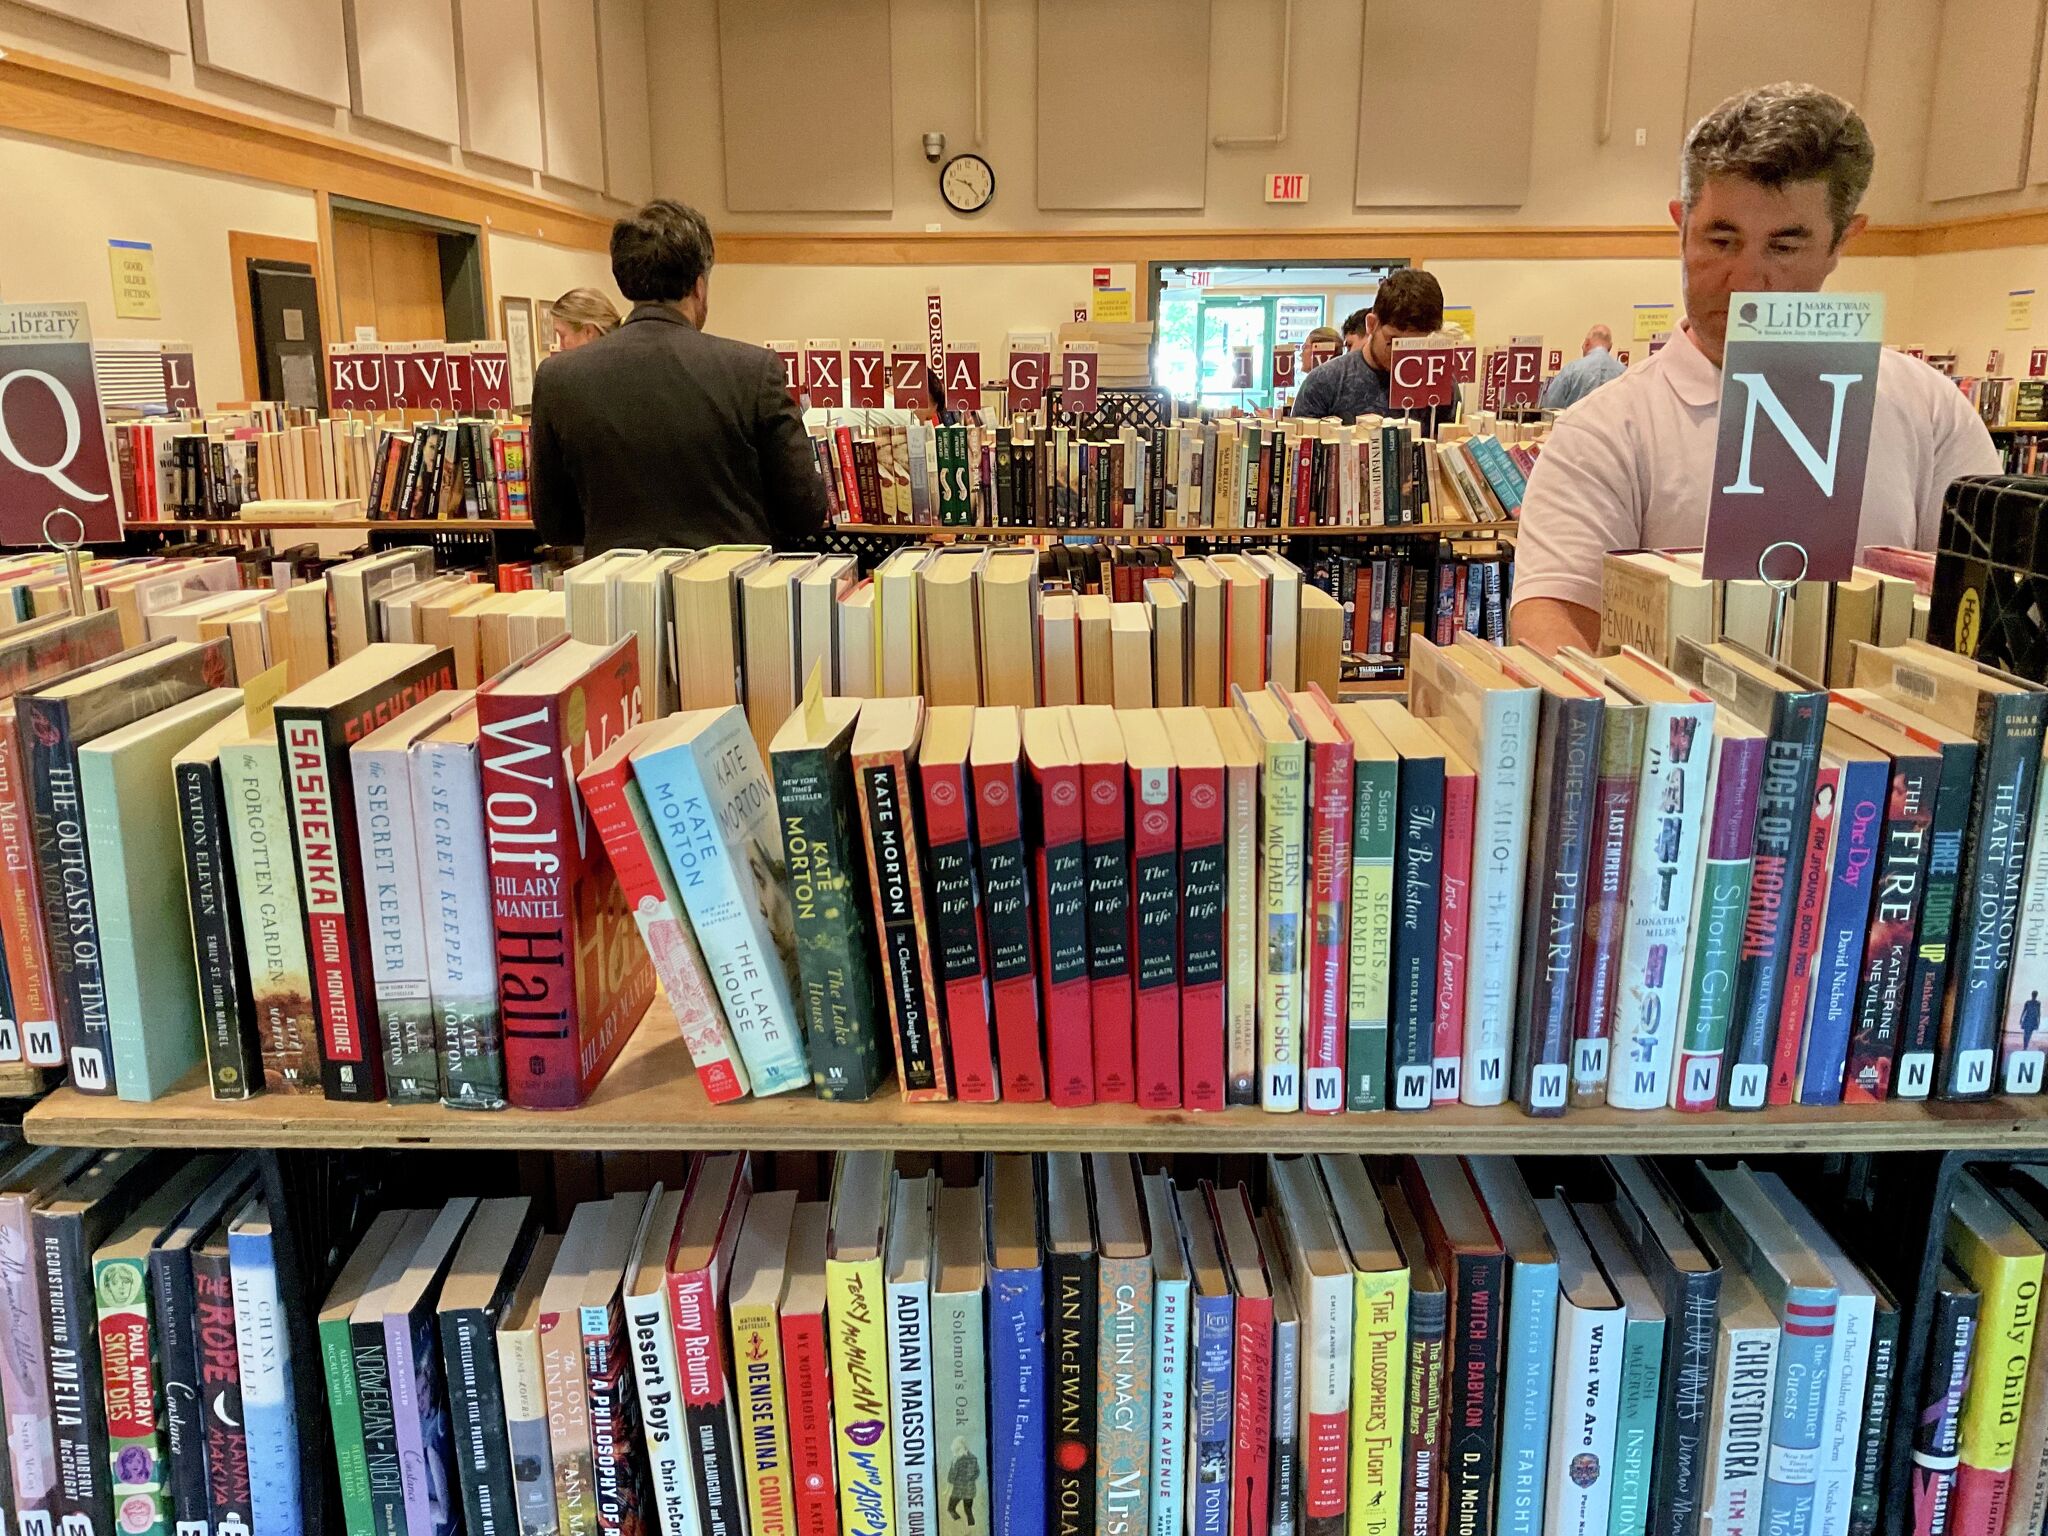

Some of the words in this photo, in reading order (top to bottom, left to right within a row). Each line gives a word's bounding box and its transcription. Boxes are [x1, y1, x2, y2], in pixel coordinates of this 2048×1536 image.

[1274, 176, 1303, 199] EXIT
[124, 288, 151, 299] FICTION
[1192, 272, 1209, 285] EXIT
[1765, 302, 1871, 336] Library
[168, 360, 190, 388] L
[333, 361, 353, 390] K
[352, 360, 381, 390] U
[394, 360, 406, 397] J
[415, 359, 442, 389] V
[449, 362, 461, 390] I
[475, 359, 506, 390] W
[811, 357, 839, 387] X
[853, 358, 881, 387] Y
[897, 360, 923, 389] Z
[949, 360, 976, 390] A
[1012, 360, 1039, 389] G
[1068, 361, 1090, 390] B
[1235, 358, 1250, 375] T
[1275, 356, 1294, 374] U
[1394, 357, 1423, 388] C
[1426, 357, 1446, 386] F
[1457, 351, 1473, 371] Y
[1496, 353, 1508, 375] Z
[1512, 354, 1535, 383] E
[1551, 353, 1559, 364] B
[1618, 354, 1628, 365] C
[2033, 353, 2043, 367] T
[0, 369, 109, 502] Q
[1723, 373, 1863, 498] N
[1602, 600, 1656, 654] PENMAN
[1960, 598, 1976, 655] Hood
[714, 743, 748, 791] KATE
[1761, 740, 1803, 812] EDGE
[50, 766, 74, 815] THE
[187, 771, 209, 846] STATION
[481, 706, 561, 875] Wolf
[719, 773, 771, 840] MORTON
[873, 772, 894, 822] KATE
[1903, 775, 1923, 817] THE
[290, 727, 338, 906] SASHENKA
[685, 797, 717, 859] KATE
[1361, 780, 1374, 843] Meissner
[1377, 790, 1392, 833] Susan
[1408, 805, 1436, 840] The
[1762, 813, 1792, 850] OF
[655, 782, 704, 888] MORTON
[57, 820, 92, 935] OUTCASTS
[786, 817, 815, 920] MORTON
[812, 840, 833, 892] KATE
[877, 829, 905, 915] MORTON
[990, 854, 1015, 870] The
[1190, 859, 1216, 874] The
[1267, 824, 1285, 908] MICHAELS
[1878, 829, 1924, 925] FIRE
[196, 850, 216, 916] ELEVEN
[495, 876, 561, 897] HILARY
[987, 875, 1021, 894] Paris
[1185, 881, 1220, 899] Paris
[1405, 842, 1433, 931] Bookstore
[496, 898, 565, 919] MANTEL
[992, 897, 1021, 915] Wife
[1189, 903, 1217, 920] Wife
[1352, 875, 1370, 966] CHARMED
[1635, 915, 1686, 927] JONATHAN
[1704, 884, 1741, 964] Short
[1741, 854, 1793, 962] NORMAL
[318, 918, 341, 963] SIMON
[1545, 870, 1578, 983] PEARL
[1645, 927, 1677, 937] MILES
[75, 937, 99, 969] OF
[996, 957, 1027, 968] McLAIN
[997, 944, 1024, 955] PAULA
[1189, 950, 1216, 961] PAULA
[1835, 929, 1854, 966] David
[497, 926, 570, 1041] Hall
[1188, 962, 1218, 974] McLAIN
[80, 973, 108, 1034] TIME
[325, 965, 353, 1056] MONTEFIORE
[719, 963, 754, 1033] HOUSE
[734, 940, 758, 983] THE
[751, 987, 779, 1042] LAKE
[1350, 970, 1366, 1011] LIFE
[1696, 975, 1728, 1036] Girls
[1827, 967, 1847, 1022] Nicholls
[1860, 958, 1883, 1029] NEVILLE
[1877, 944, 1904, 1040] KATHERINE
[386, 1009, 404, 1067] MORTON
[1435, 1068, 1456, 1089] M
[1479, 1058, 1500, 1080] M
[1581, 1049, 1602, 1072] M
[1692, 1068, 1711, 1091] N
[1907, 1063, 1926, 1085] N
[1968, 1060, 1986, 1082] N
[2018, 1061, 2035, 1084] N
[1273, 1075, 1292, 1096] M
[1316, 1078, 1336, 1100] M
[1403, 1075, 1425, 1097] M
[1538, 1076, 1561, 1098] M
[1634, 1070, 1655, 1094] M
[1740, 1074, 1760, 1097] N
[44, 1236, 68, 1342] RECONSTRUCTING
[677, 1281, 703, 1332] Nanny
[1061, 1275, 1081, 1320] IAN
[1115, 1284, 1135, 1365] CAITLIN
[2006, 1281, 2038, 1345] Only
[127, 1324, 143, 1364] PAUL
[635, 1311, 665, 1386] Desert
[897, 1294, 921, 1373] ADRIAN
[952, 1309, 966, 1390] Solomon's
[1587, 1324, 1604, 1373] What
[103, 1332, 128, 1381] SKIPPY
[684, 1334, 710, 1396] Returns
[49, 1345, 83, 1427] AMELIA
[131, 1365, 153, 1428] MURRAY
[354, 1345, 393, 1442] NORWEGIAN
[1061, 1328, 1081, 1434] McEWAN
[1586, 1378, 1600, 1408] We
[1783, 1363, 1807, 1421] Guests
[1998, 1354, 2028, 1426] Child
[109, 1383, 132, 1423] DIES
[648, 1391, 672, 1443] Boys
[901, 1379, 925, 1467] MAGSON
[955, 1395, 968, 1427] Oak
[1115, 1373, 1134, 1434] MACY
[1723, 1339, 1771, 1481] CHRISTODORA
[1582, 1412, 1597, 1447] Are
[369, 1452, 402, 1502] NIGHT
[903, 1473, 923, 1509] CLOSE
